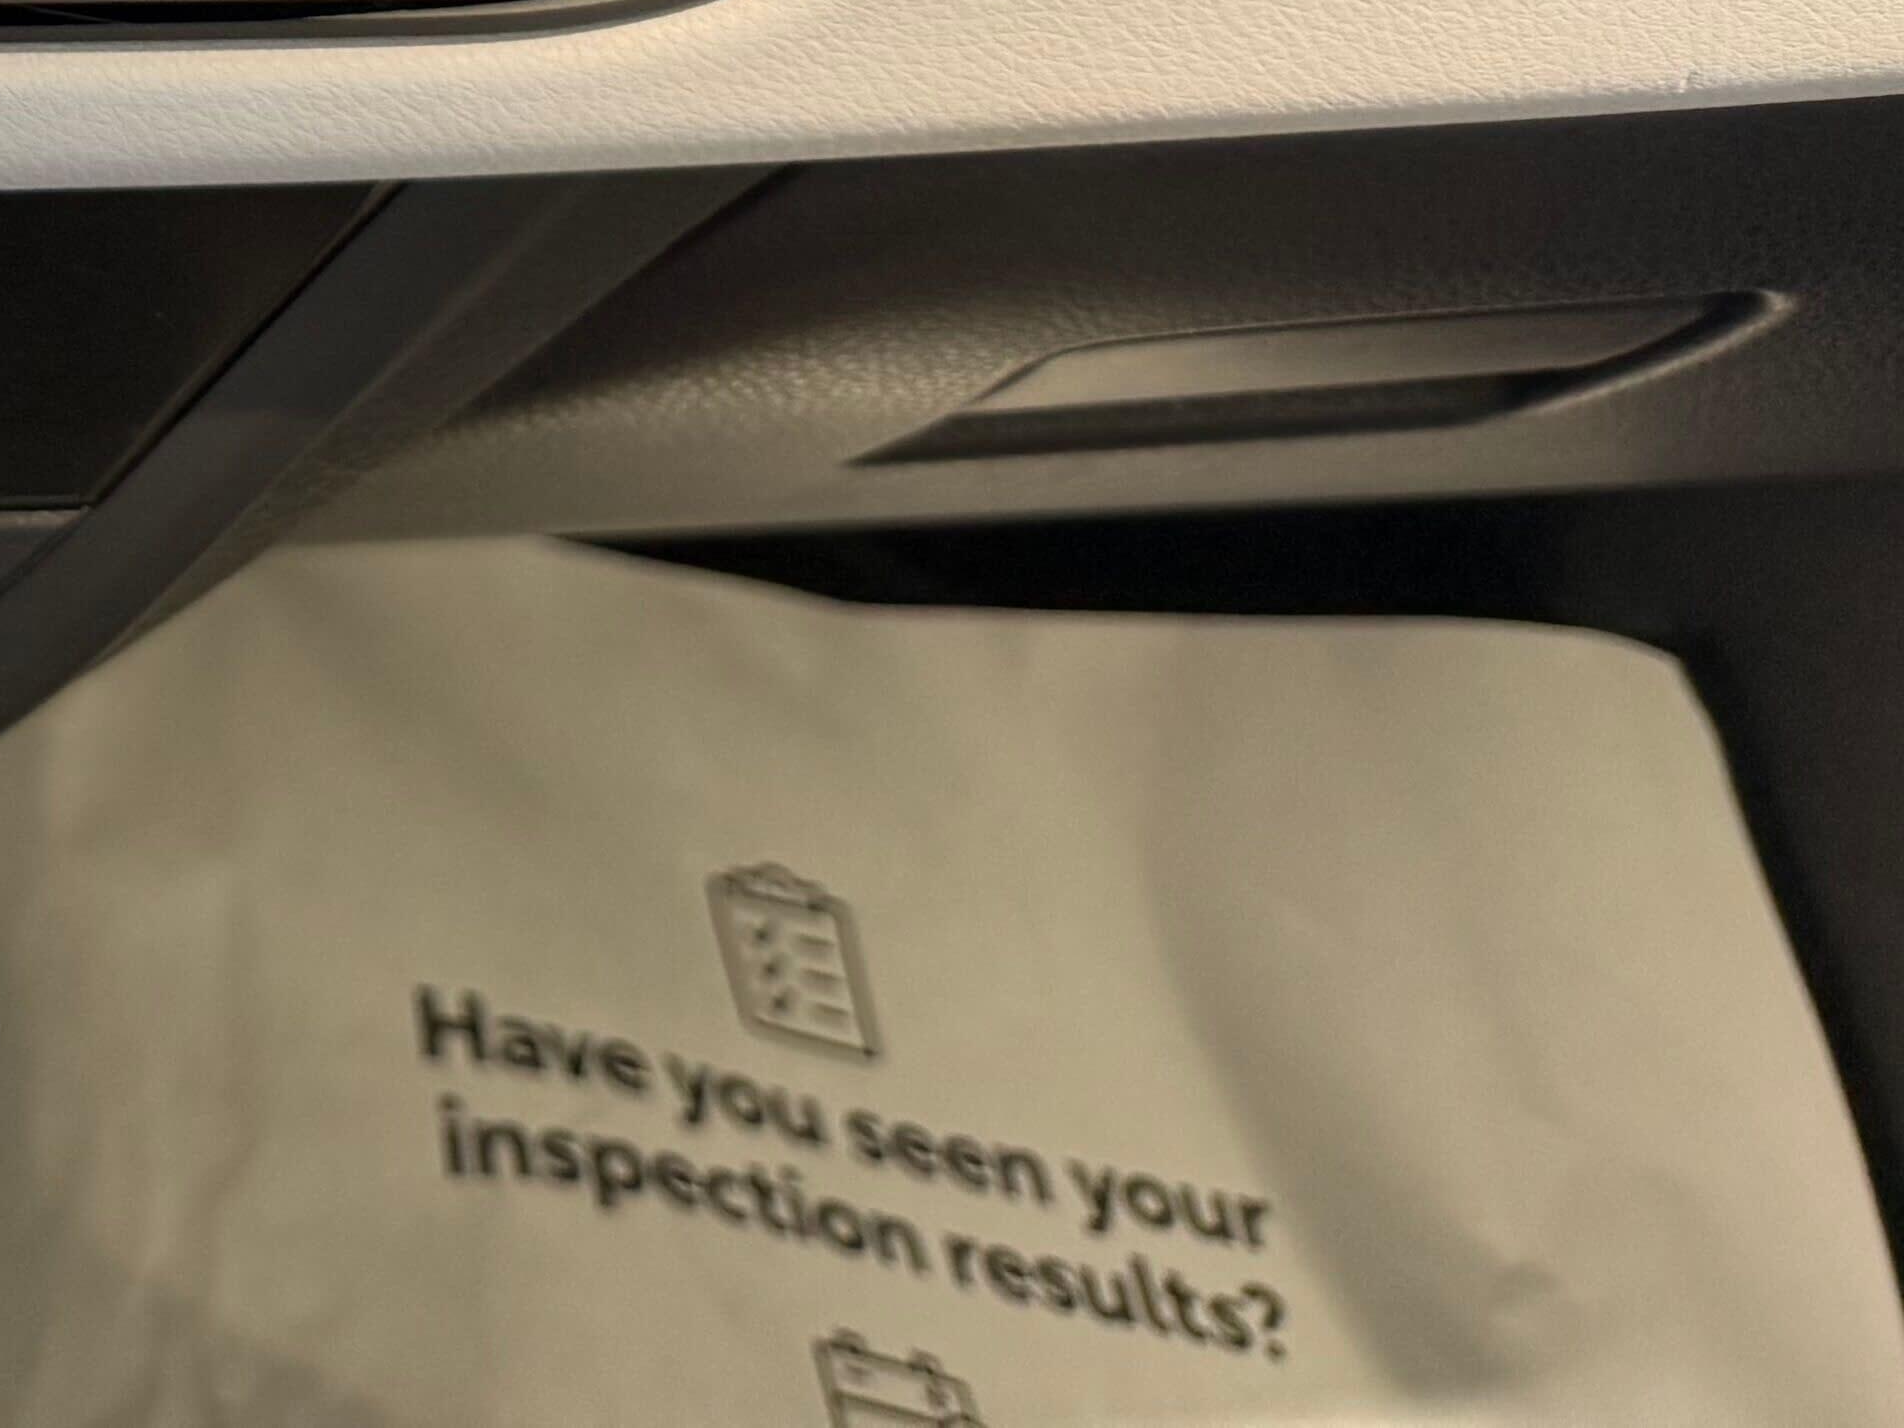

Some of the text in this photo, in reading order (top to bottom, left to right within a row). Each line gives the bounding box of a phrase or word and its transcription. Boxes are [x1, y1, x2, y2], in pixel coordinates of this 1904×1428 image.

[414, 980, 1270, 1250] Have you seen your
[434, 1092, 1290, 1364] inspection results?
